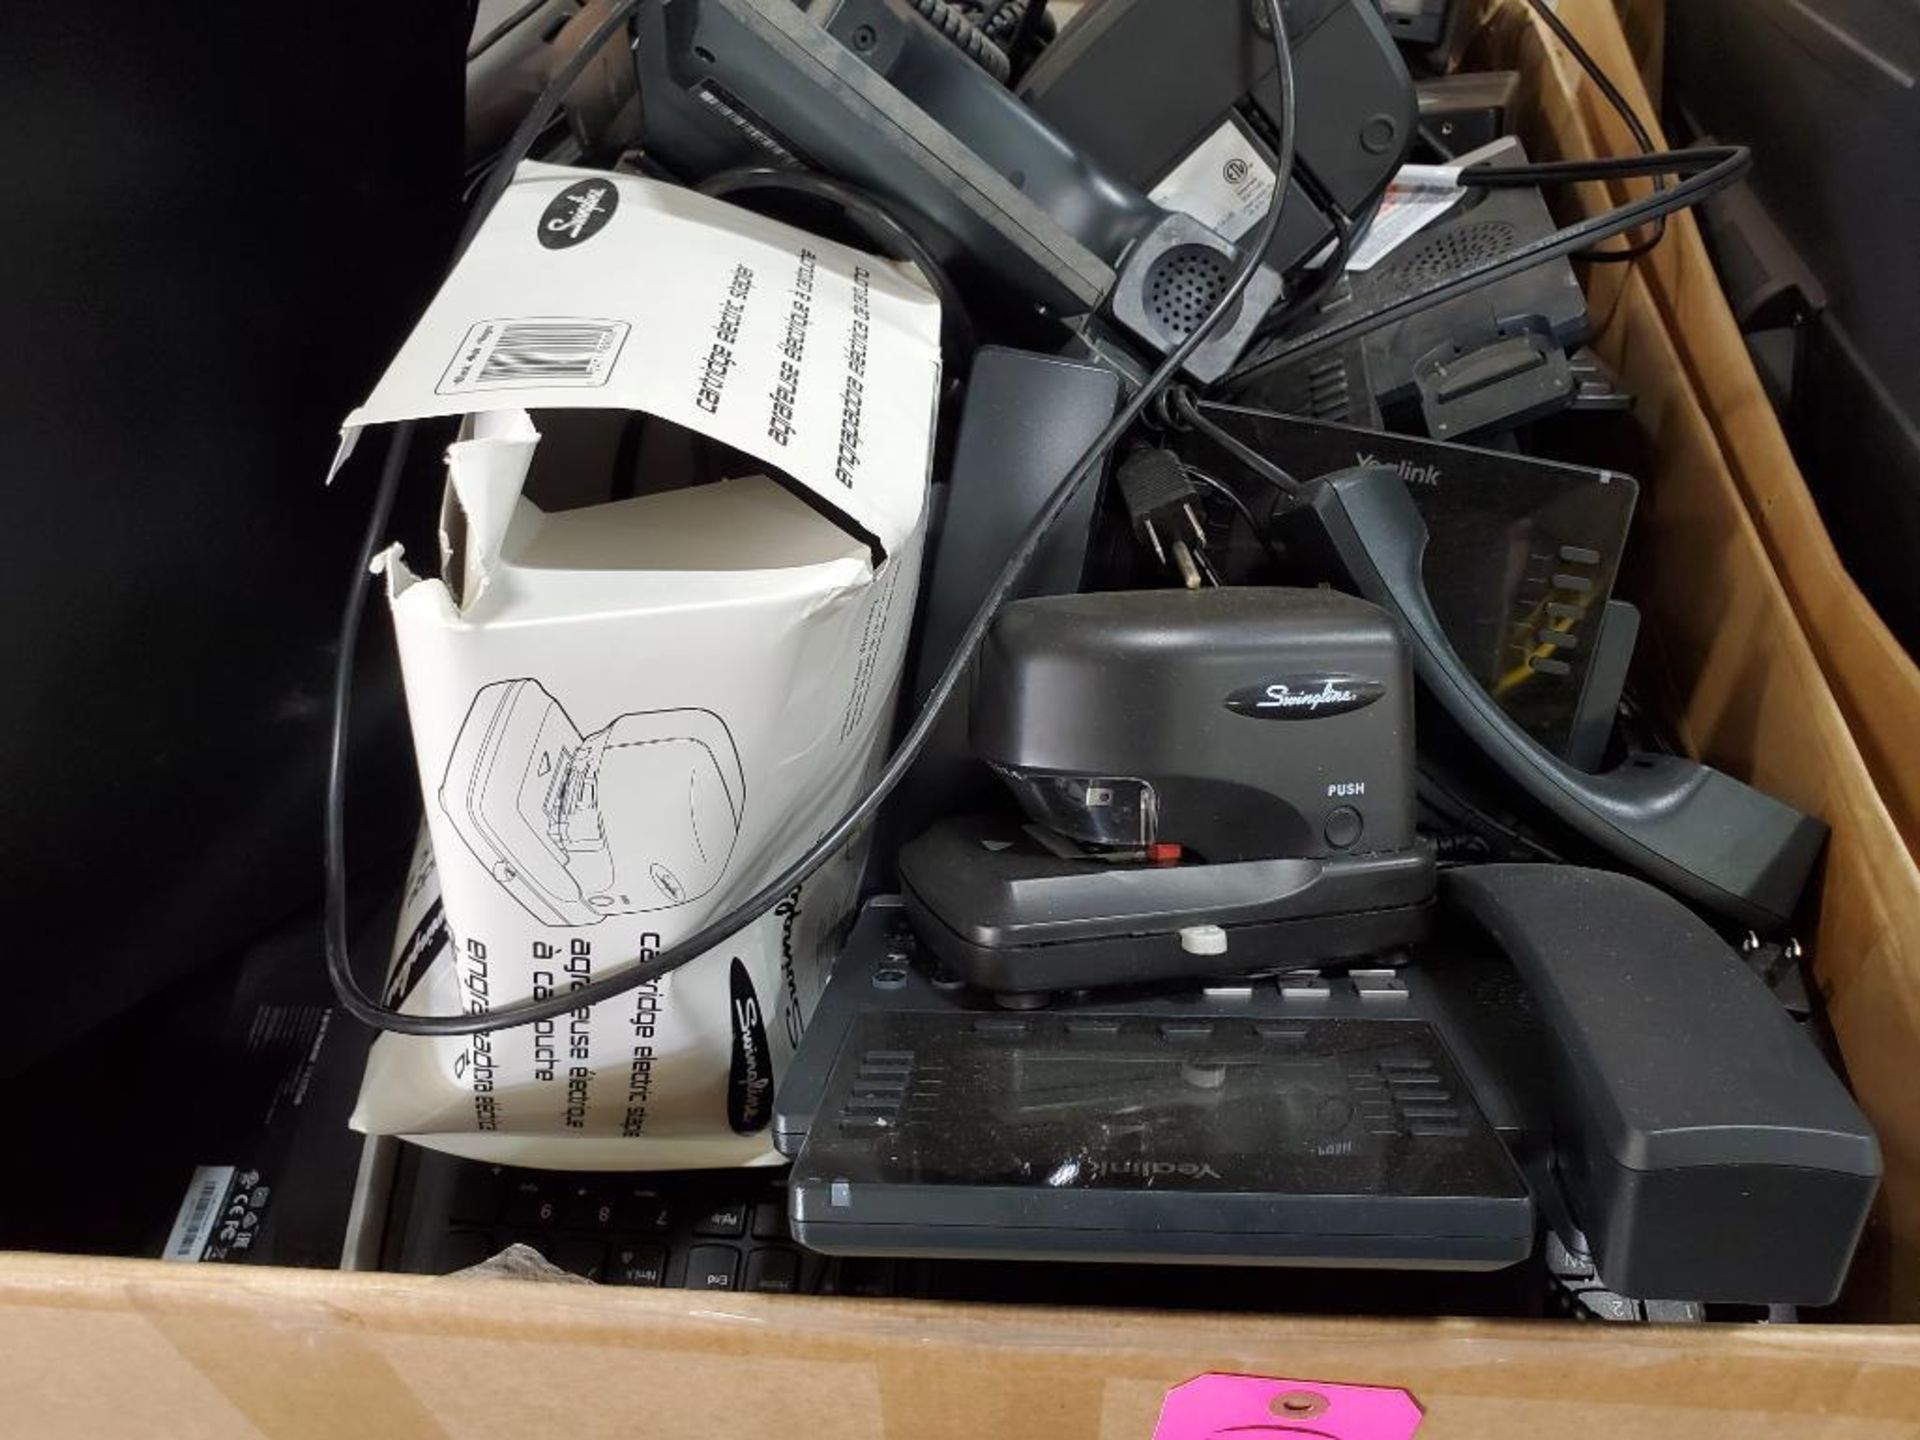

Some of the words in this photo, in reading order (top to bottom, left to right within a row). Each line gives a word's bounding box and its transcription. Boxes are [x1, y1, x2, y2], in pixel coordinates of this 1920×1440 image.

[713, 299, 745, 345] electric
[695, 342, 737, 415] cartridge
[768, 360, 800, 447] agrafeuse
[835, 375, 865, 490] engrapadora
[1355, 451, 1443, 487] Ylink
[1256, 682, 1352, 710] Swingline
[1327, 782, 1366, 797] PUSH
[533, 940, 563, 960] à
[564, 937, 592, 1060] agraeuse
[630, 931, 664, 1039] caridge
[464, 937, 501, 1093] engraadora
[533, 970, 561, 1082] caouche
[629, 1046, 658, 1103] electric
[736, 997, 769, 1122] Swingline
[1089, 1160, 1222, 1179] Yealink
[599, 1205, 611, 1223] 8
[706, 1273, 729, 1287] End
